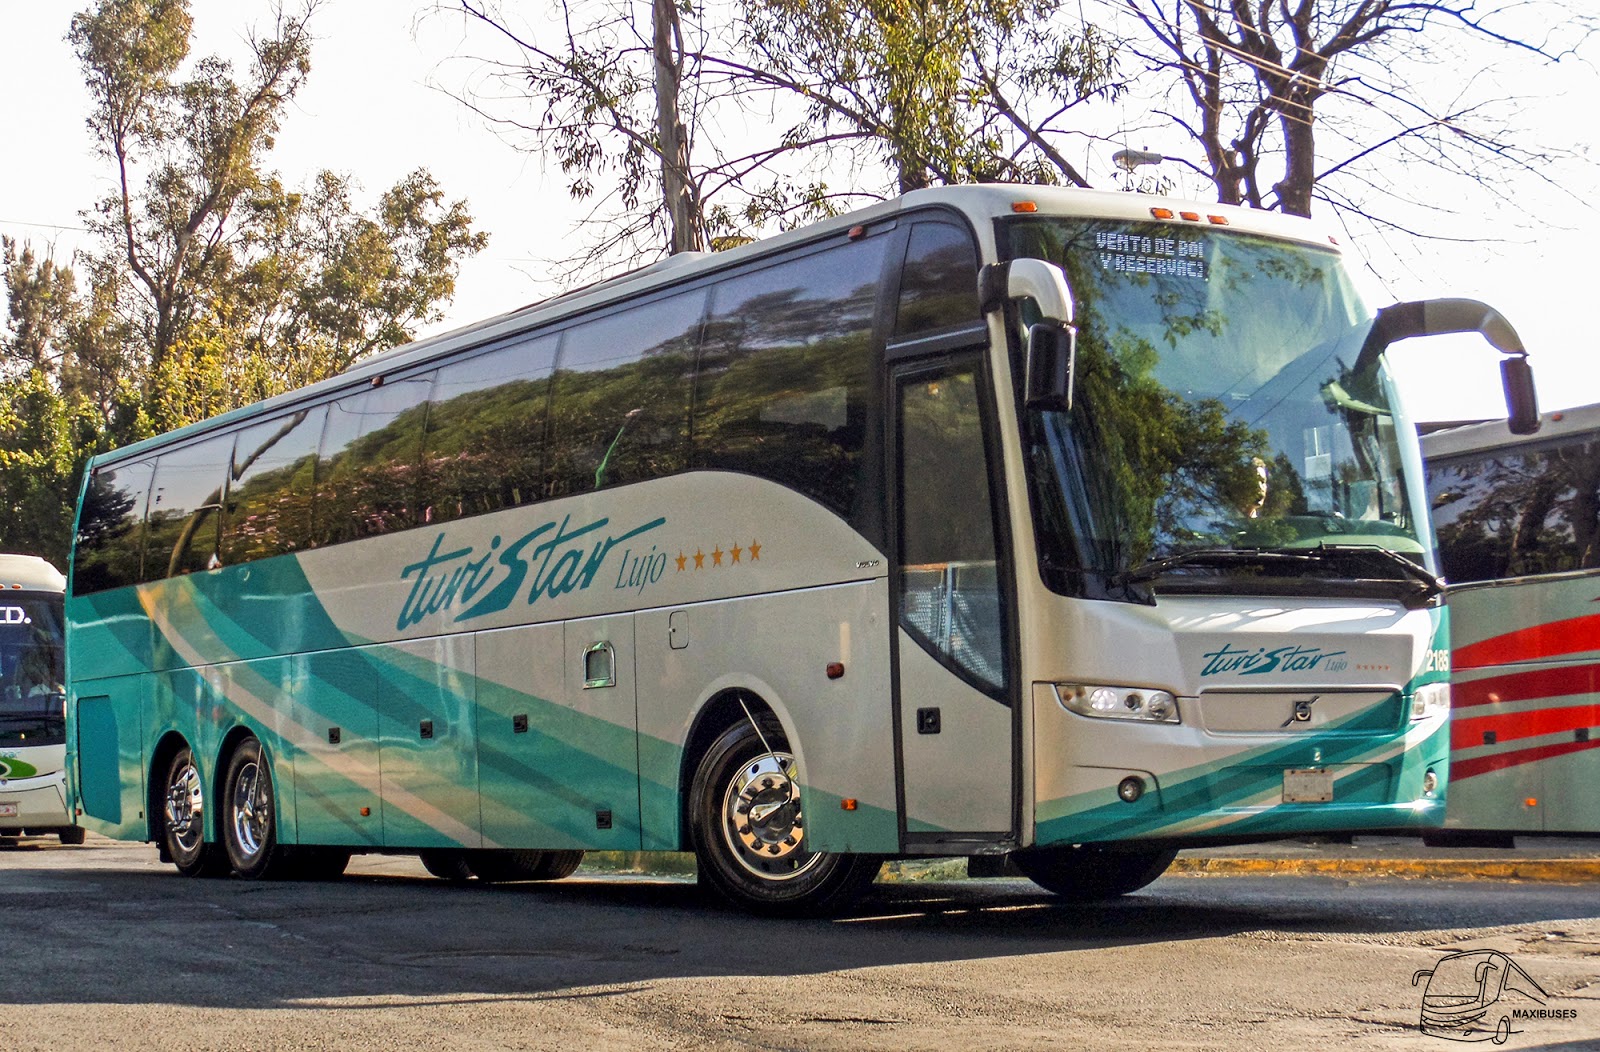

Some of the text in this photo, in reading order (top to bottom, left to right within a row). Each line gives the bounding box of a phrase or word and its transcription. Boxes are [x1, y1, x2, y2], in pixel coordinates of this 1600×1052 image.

[1096, 232, 1151, 253] VENTA
[1155, 238, 1175, 256] DE
[1100, 252, 1112, 269] Y
[614, 544, 667, 597] Lujo
[1324, 657, 1348, 673] Lujo
[1425, 649, 1449, 672] 2185
